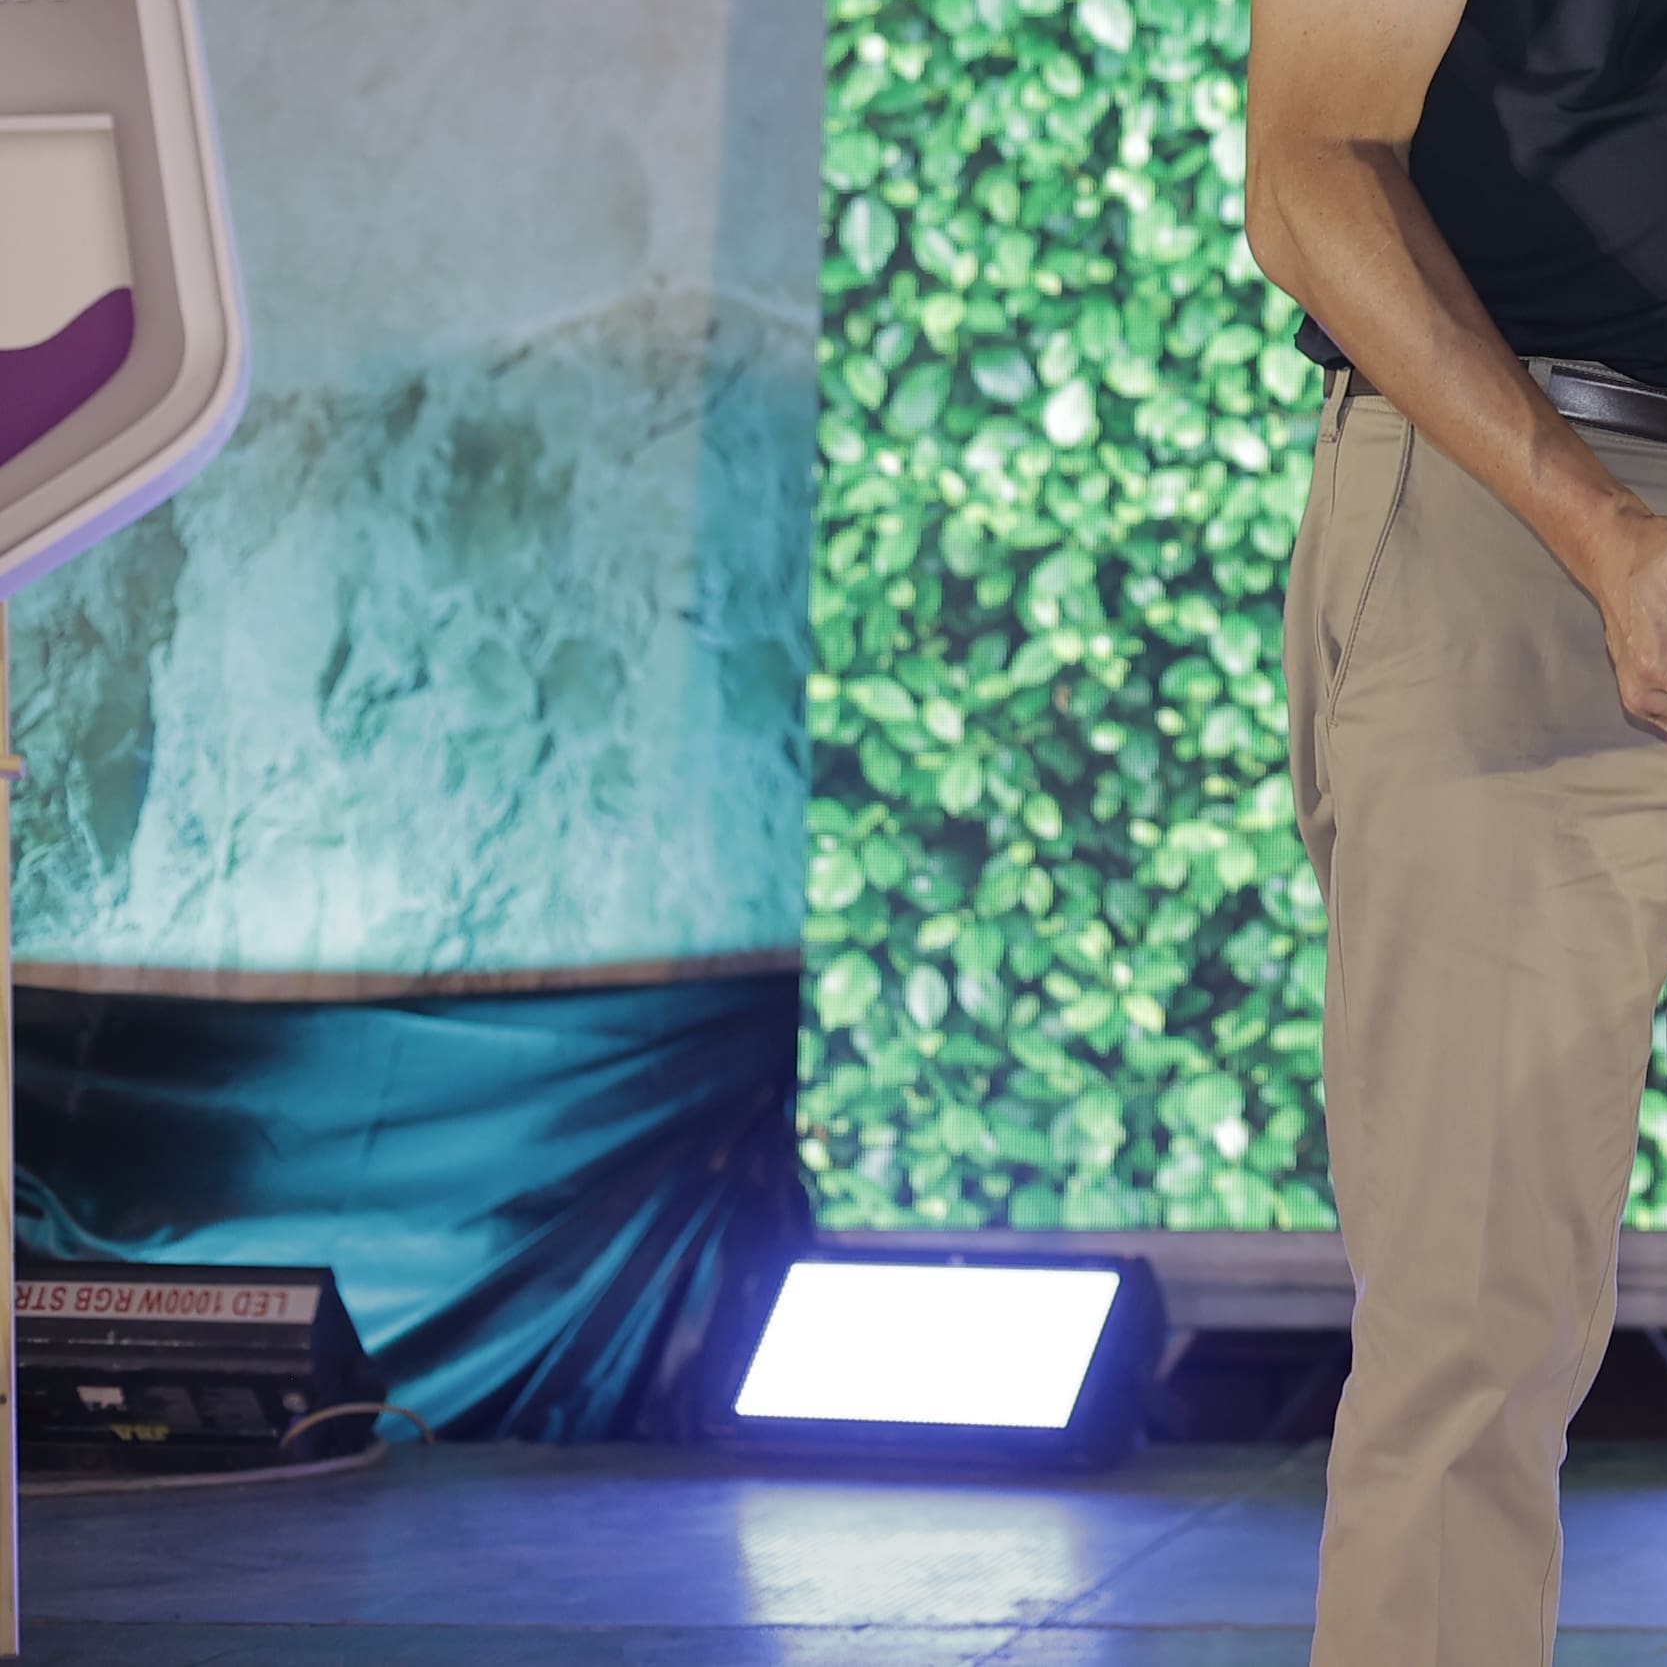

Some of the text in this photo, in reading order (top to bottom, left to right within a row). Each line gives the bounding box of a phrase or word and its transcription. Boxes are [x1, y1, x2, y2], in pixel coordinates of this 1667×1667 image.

[74, 1286, 133, 1313] RGB
[138, 1288, 223, 1314] 1000W
[232, 1289, 288, 1316] LED
